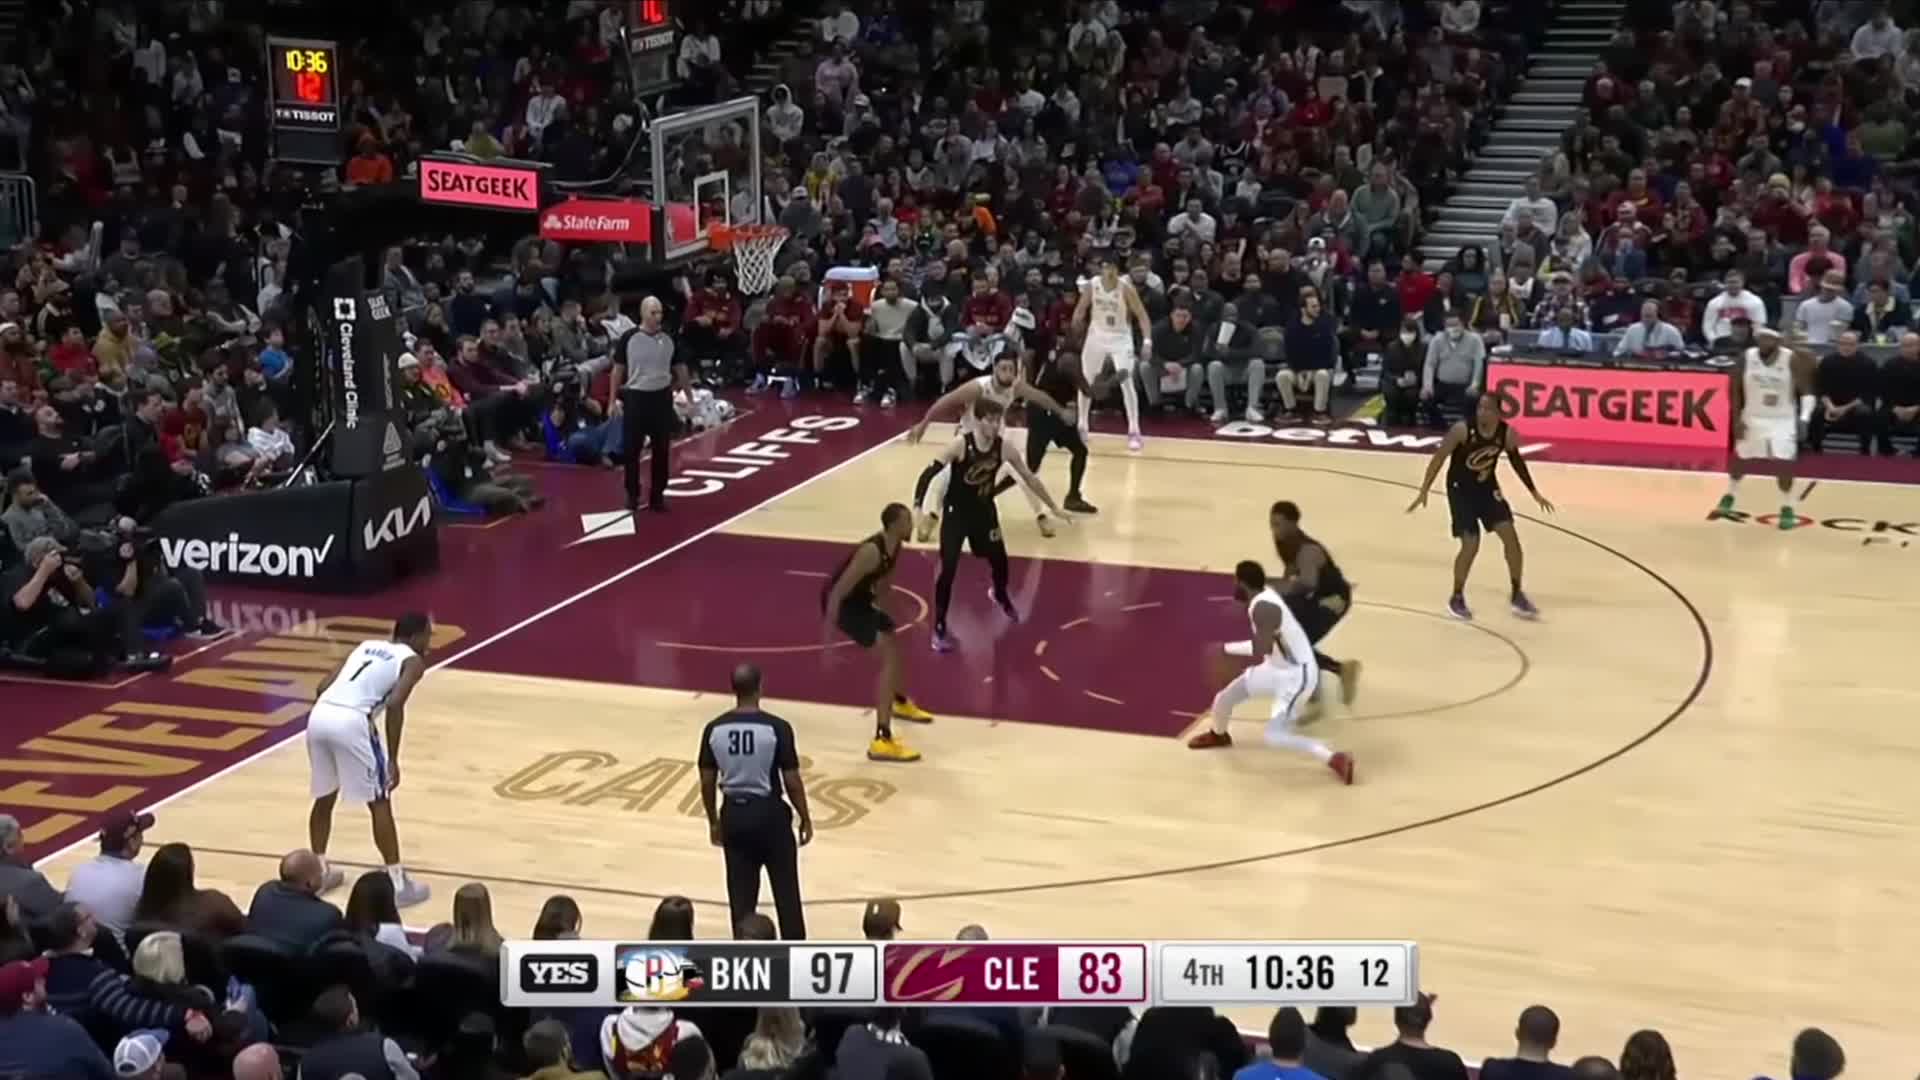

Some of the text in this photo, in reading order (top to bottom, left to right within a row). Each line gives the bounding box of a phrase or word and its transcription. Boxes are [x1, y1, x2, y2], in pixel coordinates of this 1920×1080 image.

[286, 50, 328, 73] 10:36
[297, 73, 321, 101] 12
[292, 109, 335, 121] TISSOT
[427, 169, 529, 200] SEATGEEK
[340, 322, 359, 430] Cleveland Clinic
[1496, 379, 1721, 432] SEATGEEK
[662, 415, 860, 497] CLIFFS
[160, 532, 314, 577] verizon
[349, 660, 373, 681] 1
[728, 730, 754, 756] 30
[493, 750, 898, 829] CAS
